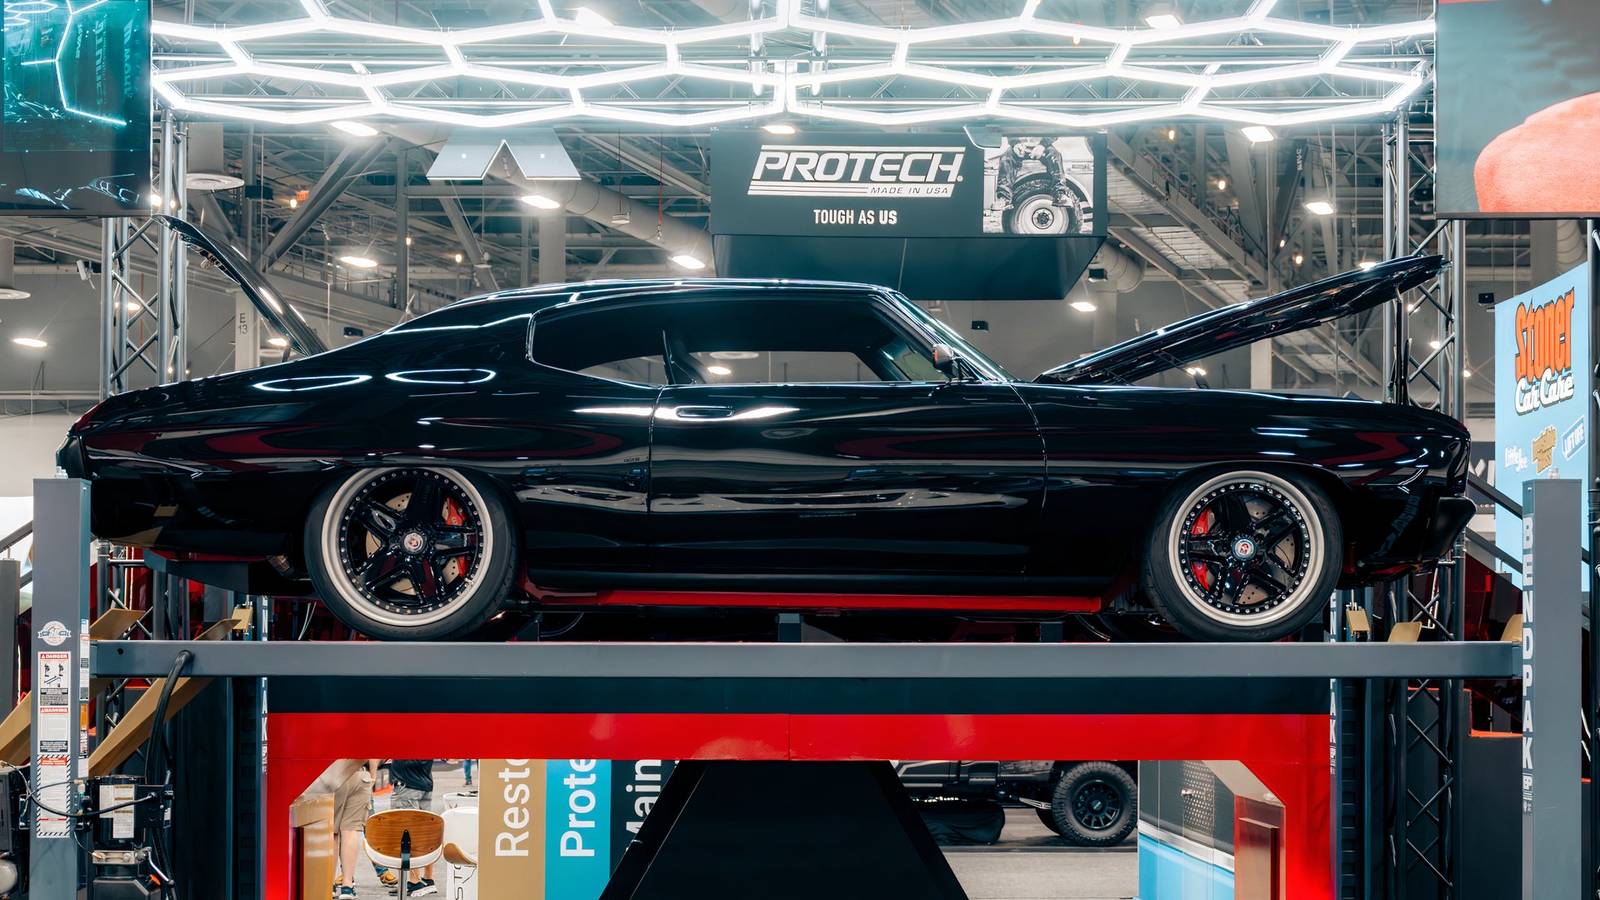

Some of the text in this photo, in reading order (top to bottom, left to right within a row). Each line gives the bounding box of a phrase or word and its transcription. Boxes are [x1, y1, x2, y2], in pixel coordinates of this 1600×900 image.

[869, 186, 949, 195] MADE IN USA
[813, 209, 897, 225] TOUGH AS US
[238, 324, 248, 335] 13
[239, 312, 246, 323] E
[1515, 287, 1574, 383] Stoner
[1515, 367, 1574, 416] Car Care
[1522, 517, 1533, 769] BENDPAK
[494, 759, 529, 857] Rest
[625, 759, 662, 852] ain
